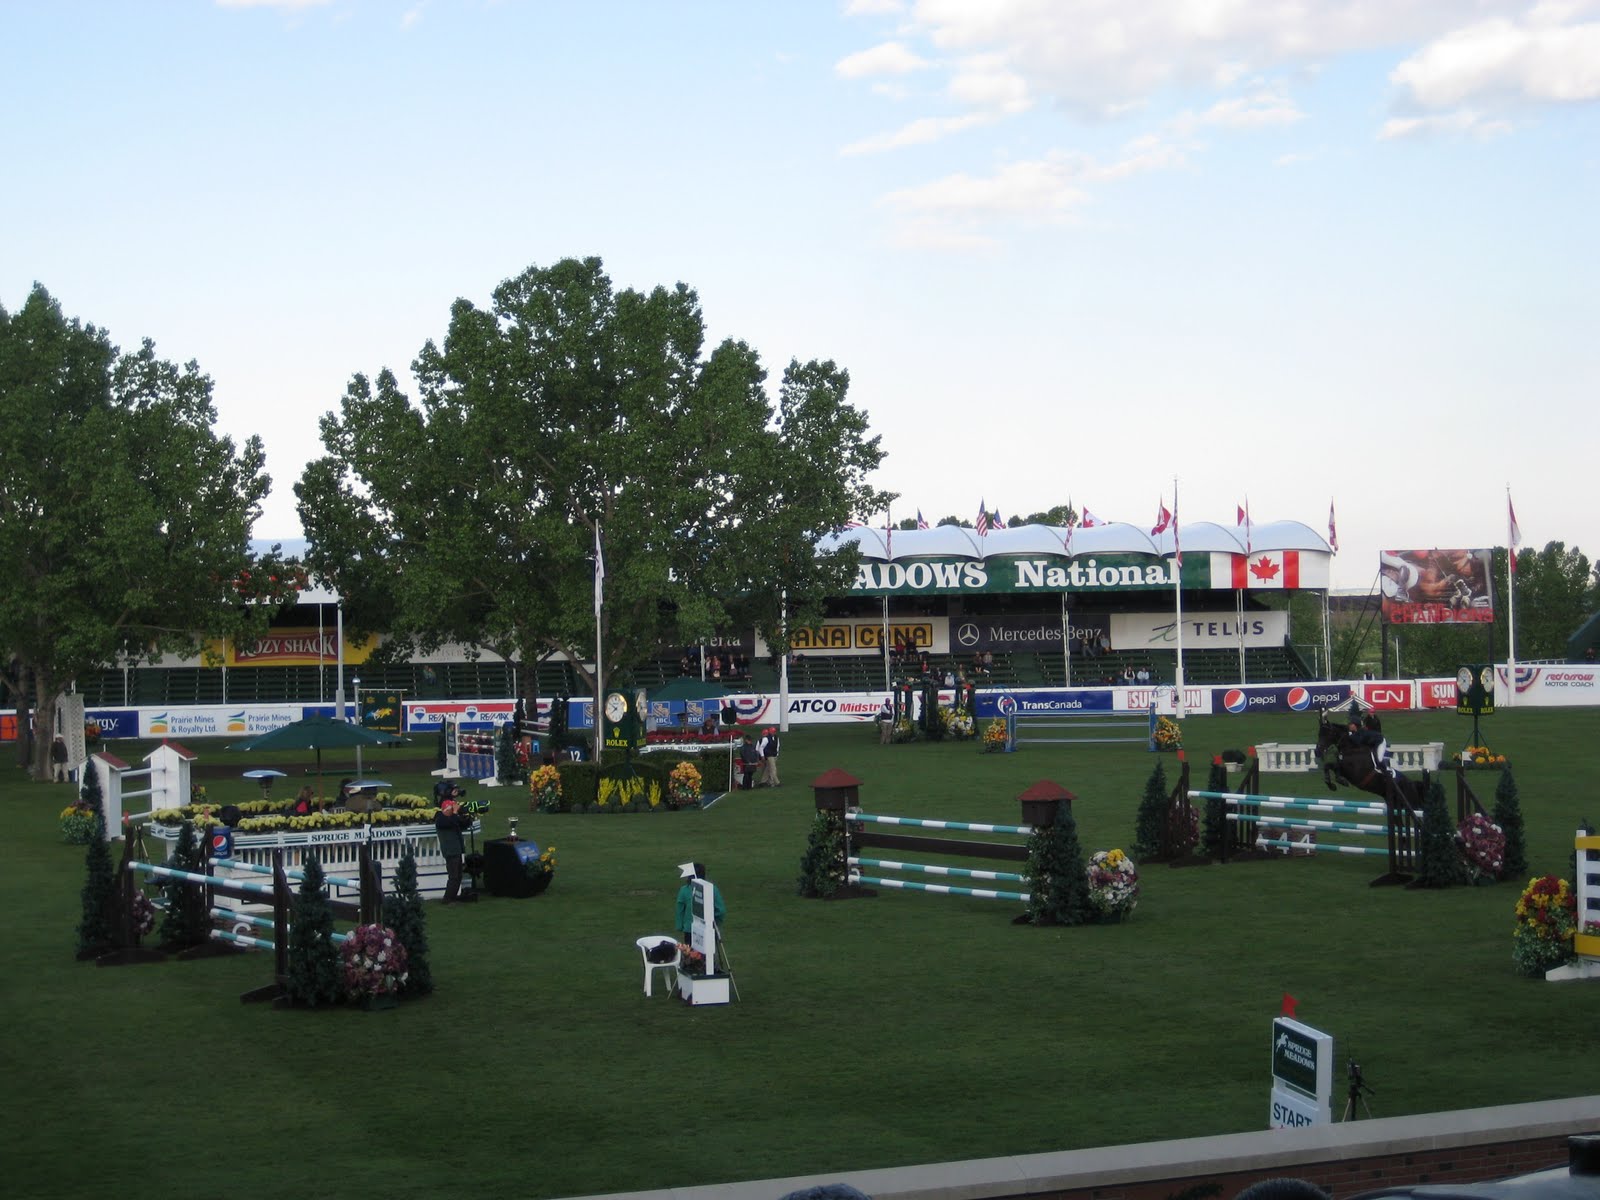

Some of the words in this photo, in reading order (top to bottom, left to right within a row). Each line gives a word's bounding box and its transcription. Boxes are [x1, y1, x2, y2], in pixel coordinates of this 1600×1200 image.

[851, 562, 988, 590] ADOWS
[1014, 558, 1181, 587] National
[1391, 608, 1494, 623] CHAMPIONS
[860, 626, 927, 645] CANA
[989, 625, 1102, 641] Mercedes-Benz
[1192, 621, 1264, 636] TELUS
[794, 628, 846, 647] ANA
[284, 635, 337, 655] SHACK
[1312, 692, 1340, 703] pepsi
[1371, 690, 1404, 703] CN
[1433, 684, 1455, 698] SUN
[1021, 700, 1082, 710] TransCanada
[1184, 690, 1200, 707] UN
[1249, 694, 1277, 706] pepsi
[788, 699, 837, 713] ATCO
[170, 716, 192, 724] Prairie
[193, 715, 215, 724] Mines
[248, 714, 270, 722] Prairie
[271, 713, 292, 722] Mines
[170, 725, 177, 733] &
[178, 724, 203, 734] Royalty
[204, 724, 218, 733] Ltd.
[606, 739, 629, 747] ROLEX
[354, 829, 403, 840] MADOWS
[1273, 1102, 1313, 1128] START
